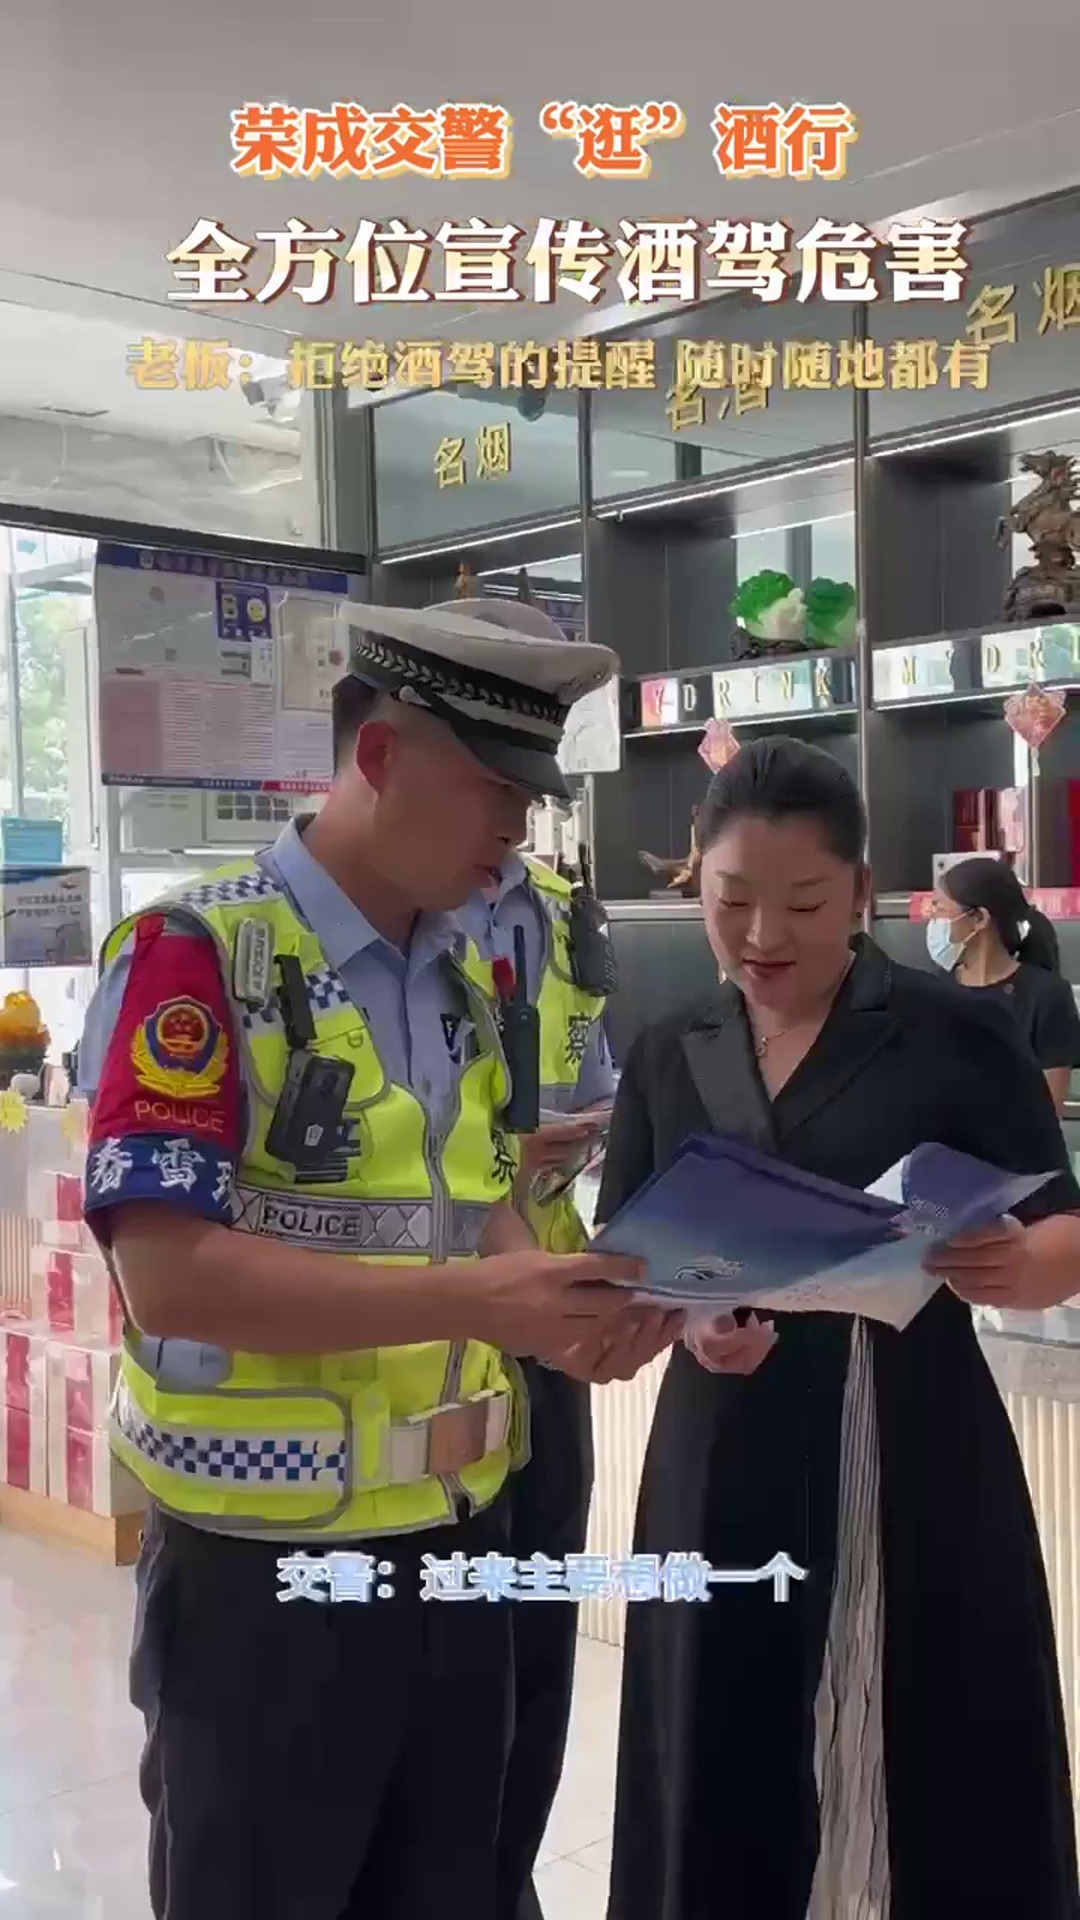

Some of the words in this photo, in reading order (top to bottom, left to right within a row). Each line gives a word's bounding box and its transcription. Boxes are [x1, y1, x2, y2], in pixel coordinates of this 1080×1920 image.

[433, 421, 511, 490] 名烟
[134, 1100, 225, 1134] POLICE
[263, 1205, 361, 1237] POLICE
